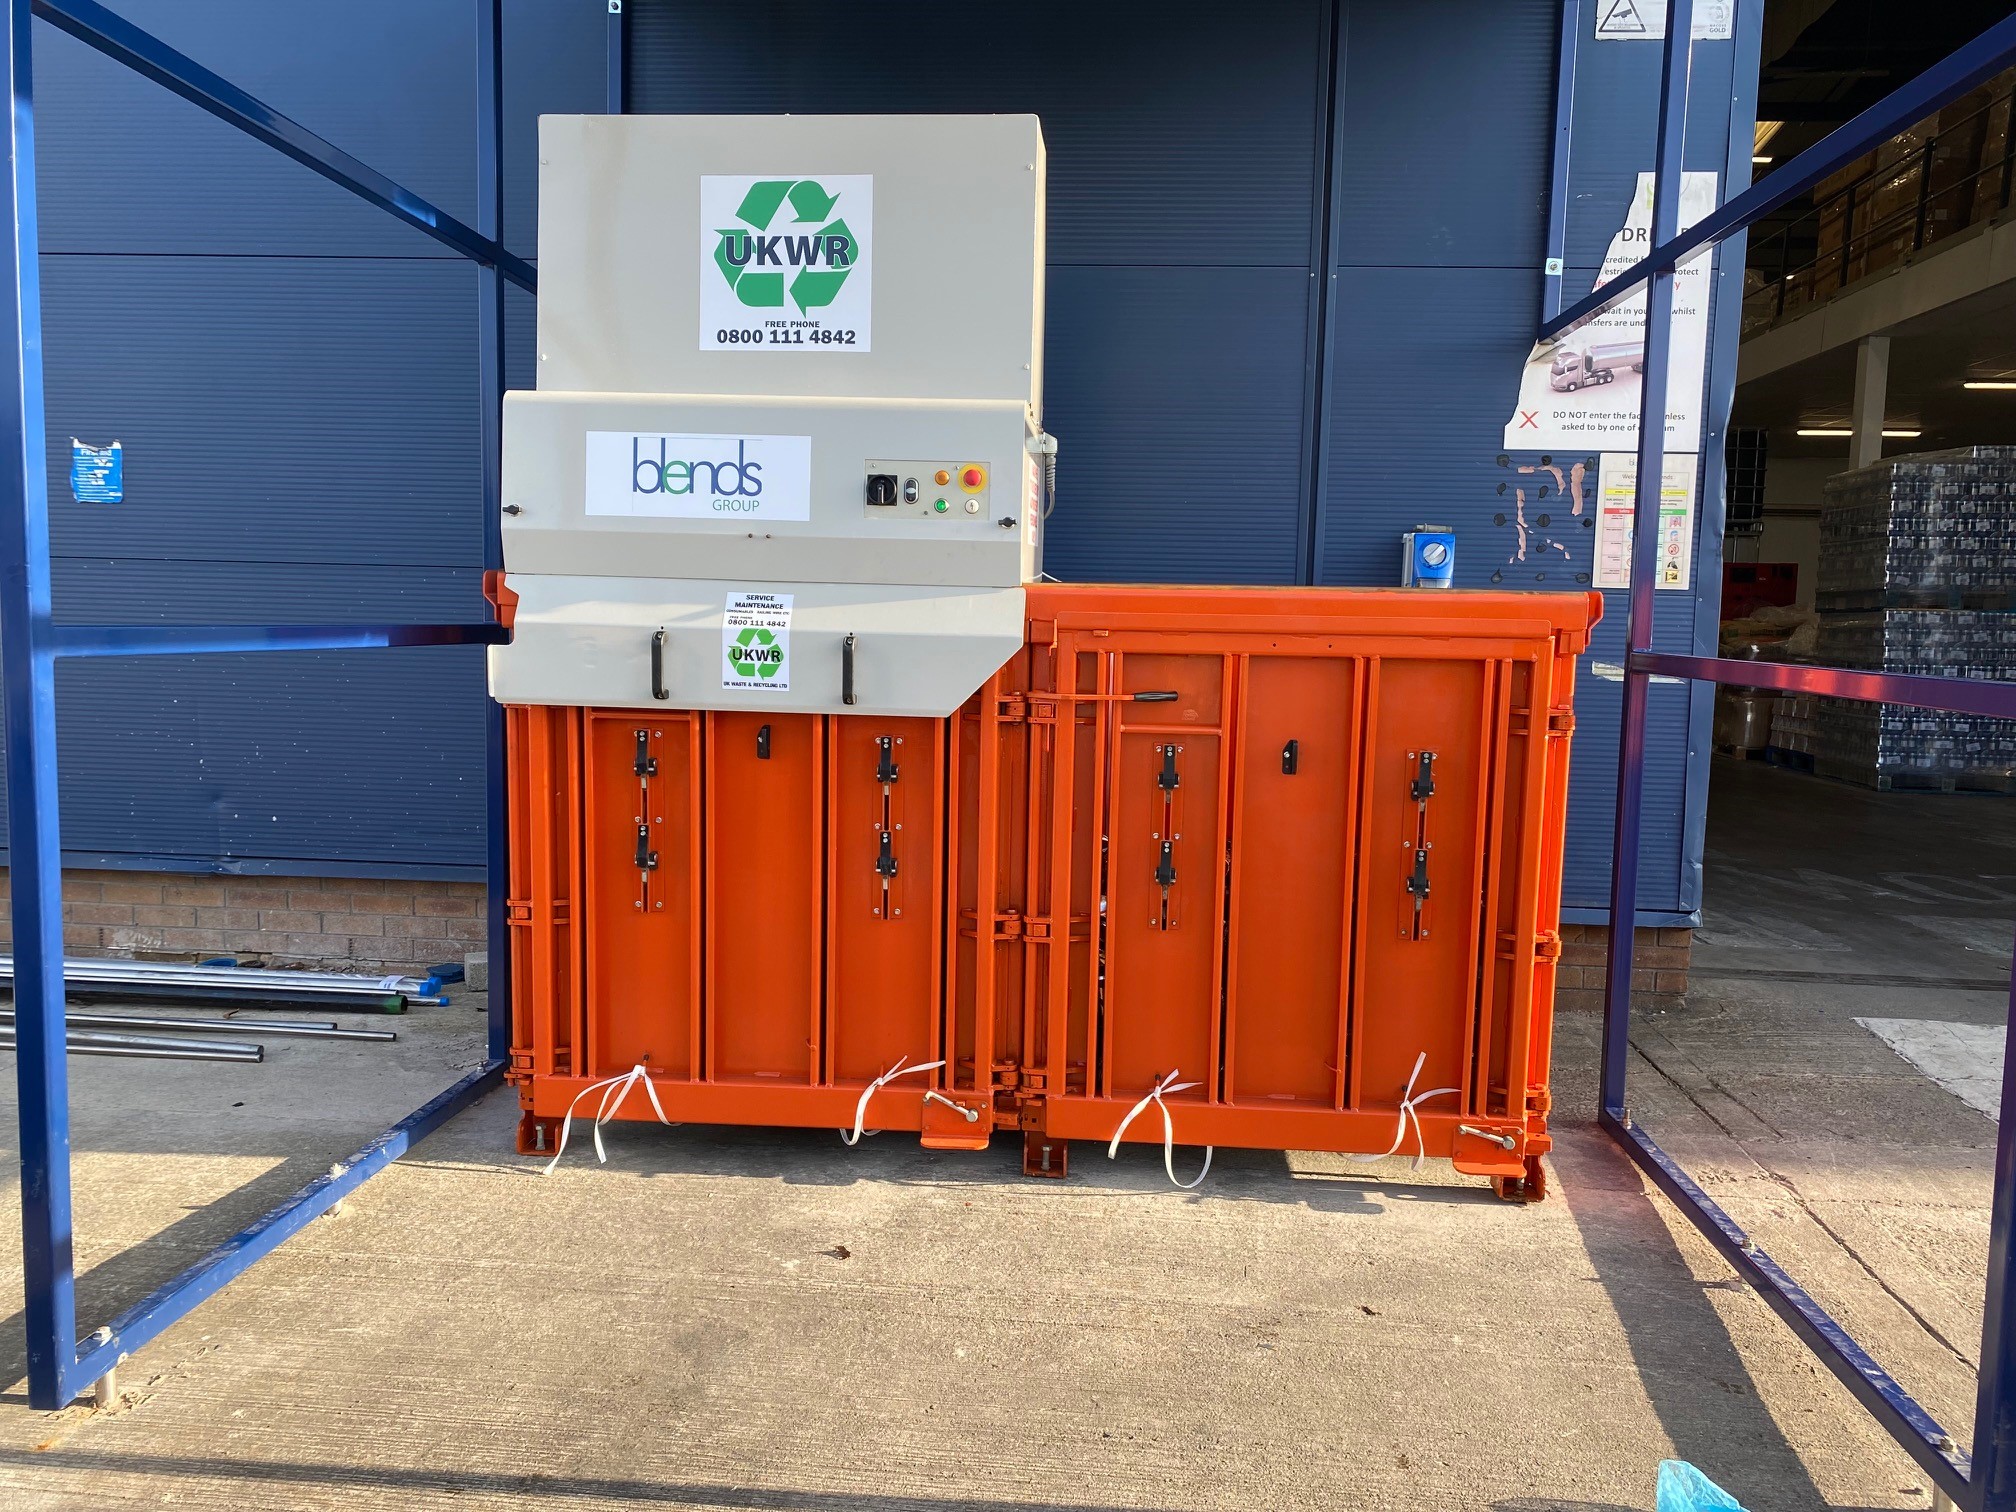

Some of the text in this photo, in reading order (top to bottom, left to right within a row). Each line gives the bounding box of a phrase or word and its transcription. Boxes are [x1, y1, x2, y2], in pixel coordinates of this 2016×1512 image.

[725, 235, 850, 266] UKWR
[1624, 307, 1632, 315] in
[765, 320, 820, 328] FREE PHONE
[716, 329, 856, 345] 0800 111 4842
[1552, 411, 1567, 419] DO
[1568, 411, 1587, 419] NOT
[1589, 412, 1611, 420] enter
[1613, 412, 1627, 420] the
[1664, 412, 1686, 420] nless
[1561, 423, 1585, 431] asked
[1587, 423, 1596, 431] to
[1597, 423, 1608, 432] by
[1626, 423, 1637, 431] of
[633, 437, 763, 497] blends
[712, 498, 760, 512] GROUP
[732, 648, 781, 663] UKWR
